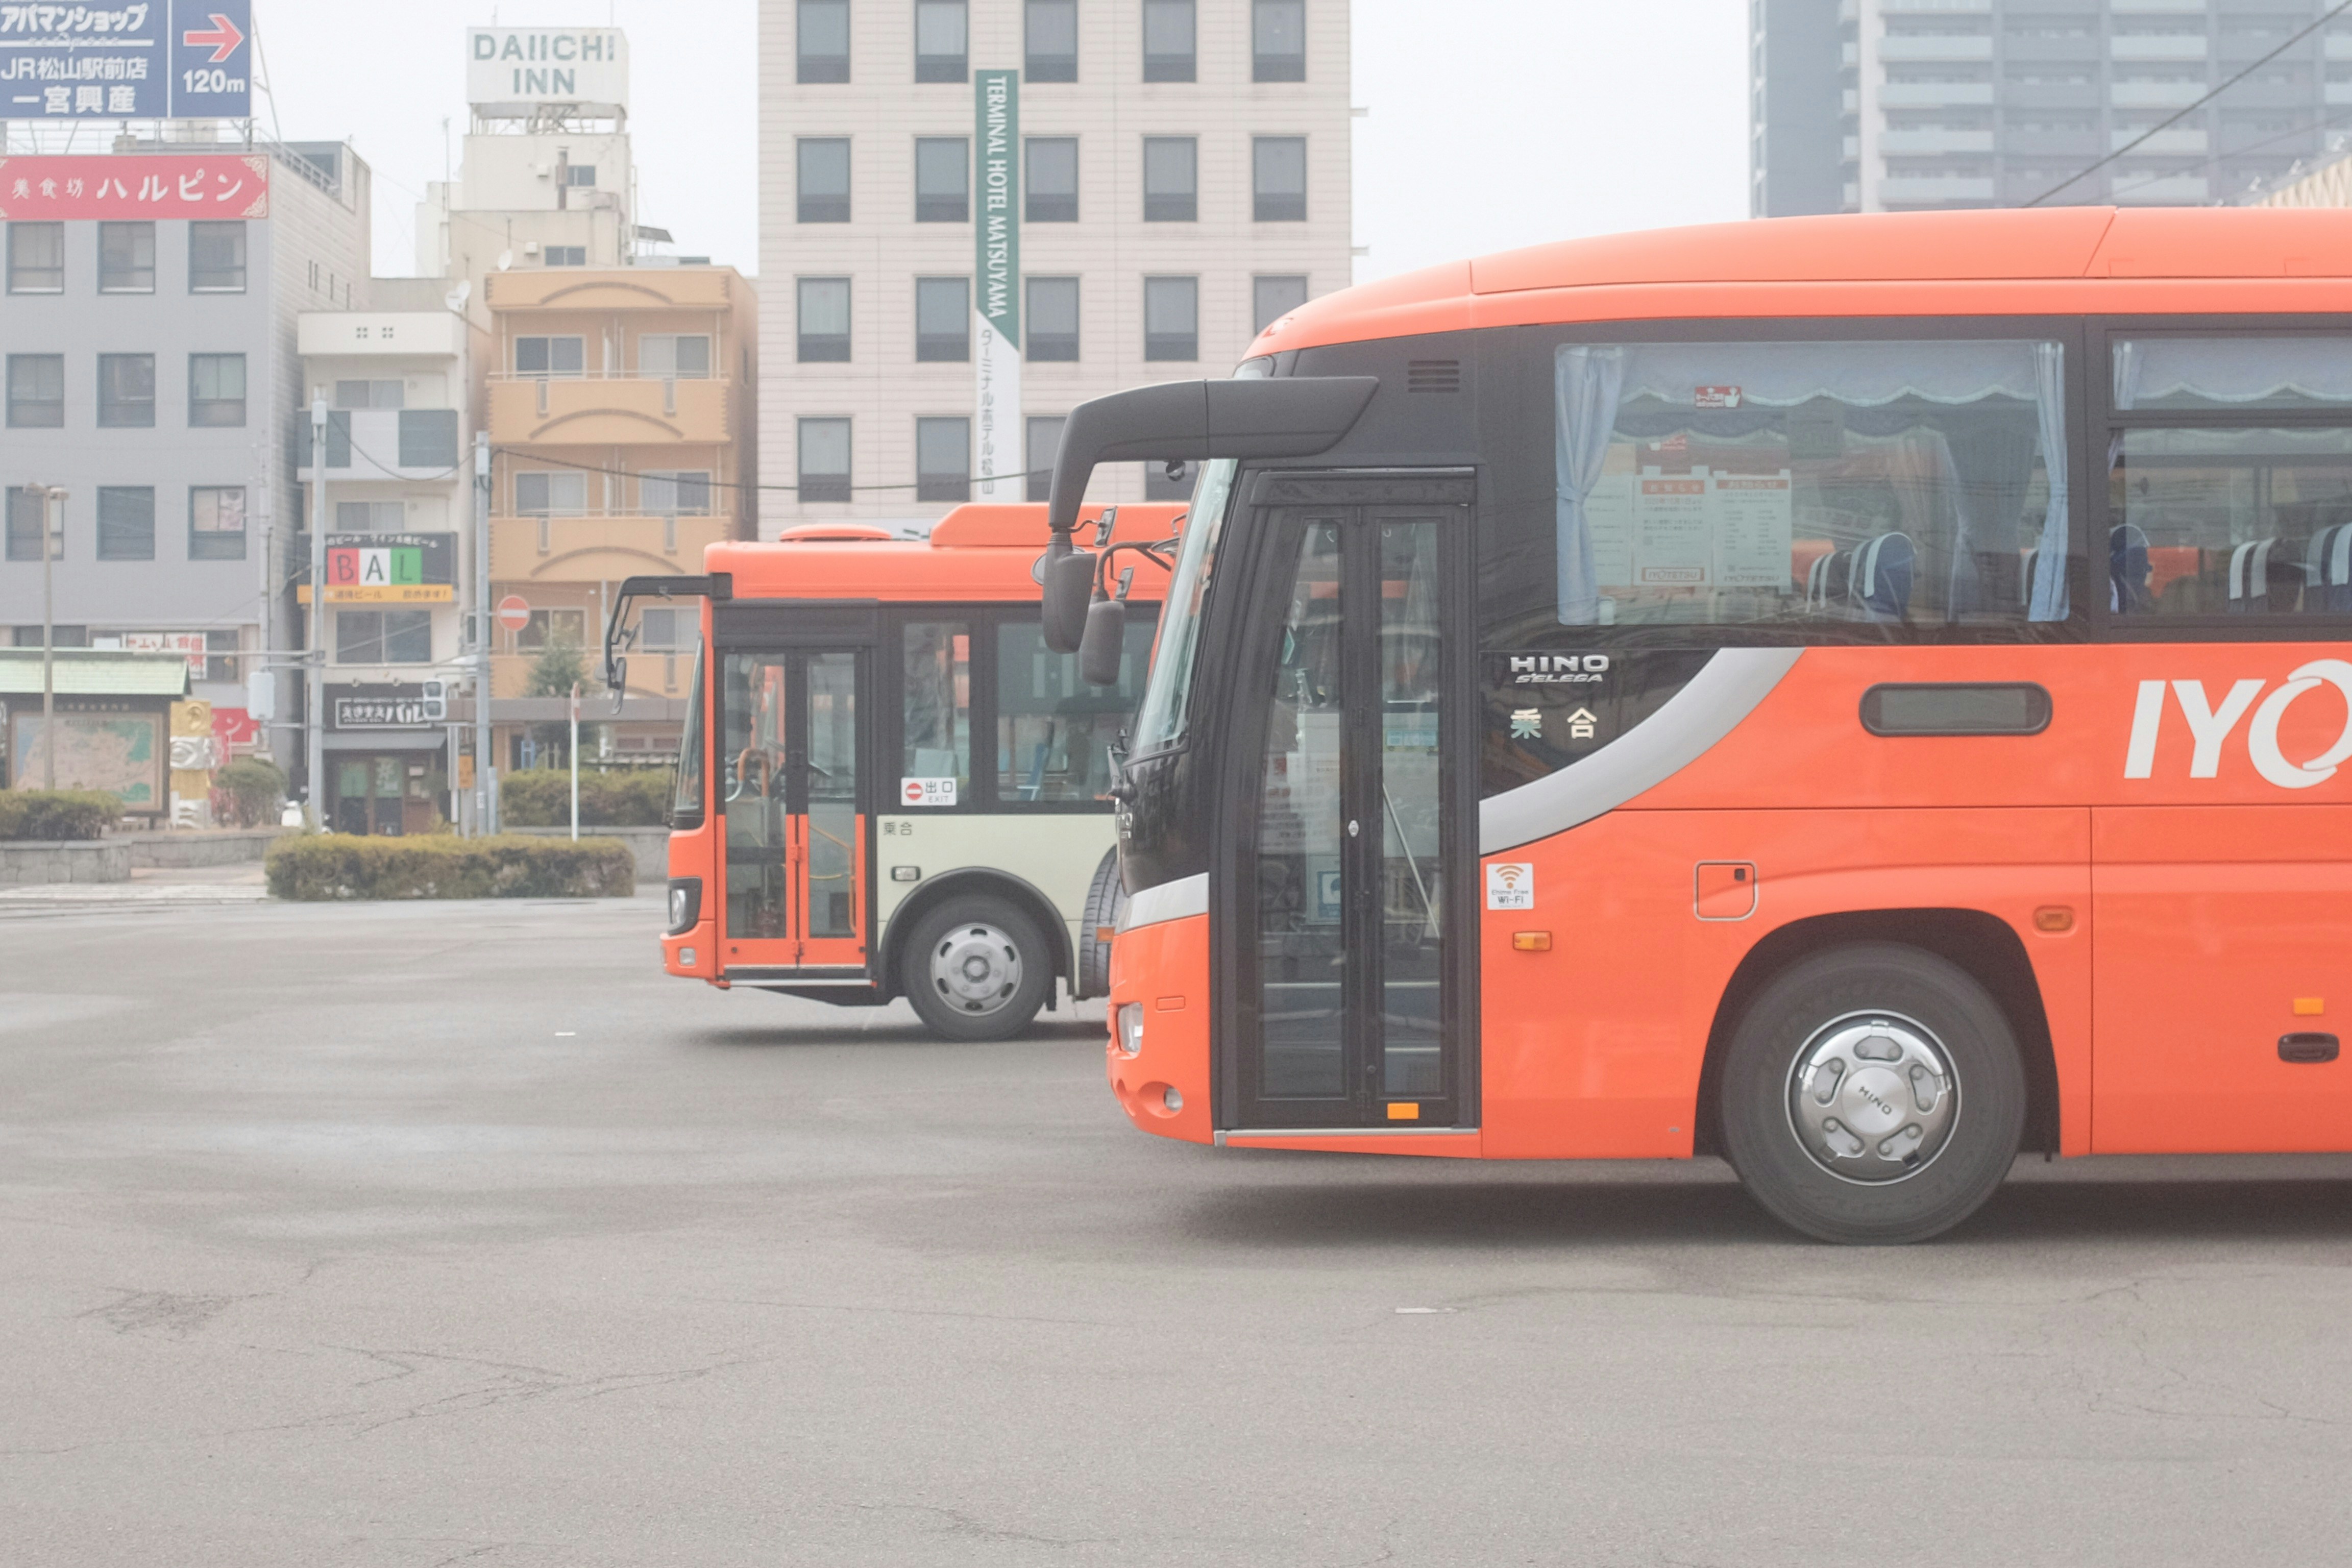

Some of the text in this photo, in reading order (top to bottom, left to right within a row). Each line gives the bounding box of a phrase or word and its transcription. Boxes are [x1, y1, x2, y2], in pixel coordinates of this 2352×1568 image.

[1, 3, 149, 32] アパマンショップ
[474, 34, 615, 61] DAIICHI
[1, 57, 148, 80] JR松山駅前店
[183, 69, 246, 93] 120m
[513, 68, 575, 94] INN
[12, 85, 136, 114] 一宮興産
[987, 76, 1008, 318] TERMINAL HOTEL MATSUYAMA
[336, 554, 412, 581] BAL
[1510, 654, 1609, 672] HINO
[1515, 673, 1603, 683] SELEGA
[2123, 658, 2352, 789] IYO
[925, 781, 953, 793] 出口
[1498, 896, 1524, 904] Wi-Fi
[1859, 1086, 1892, 1115] HINO
